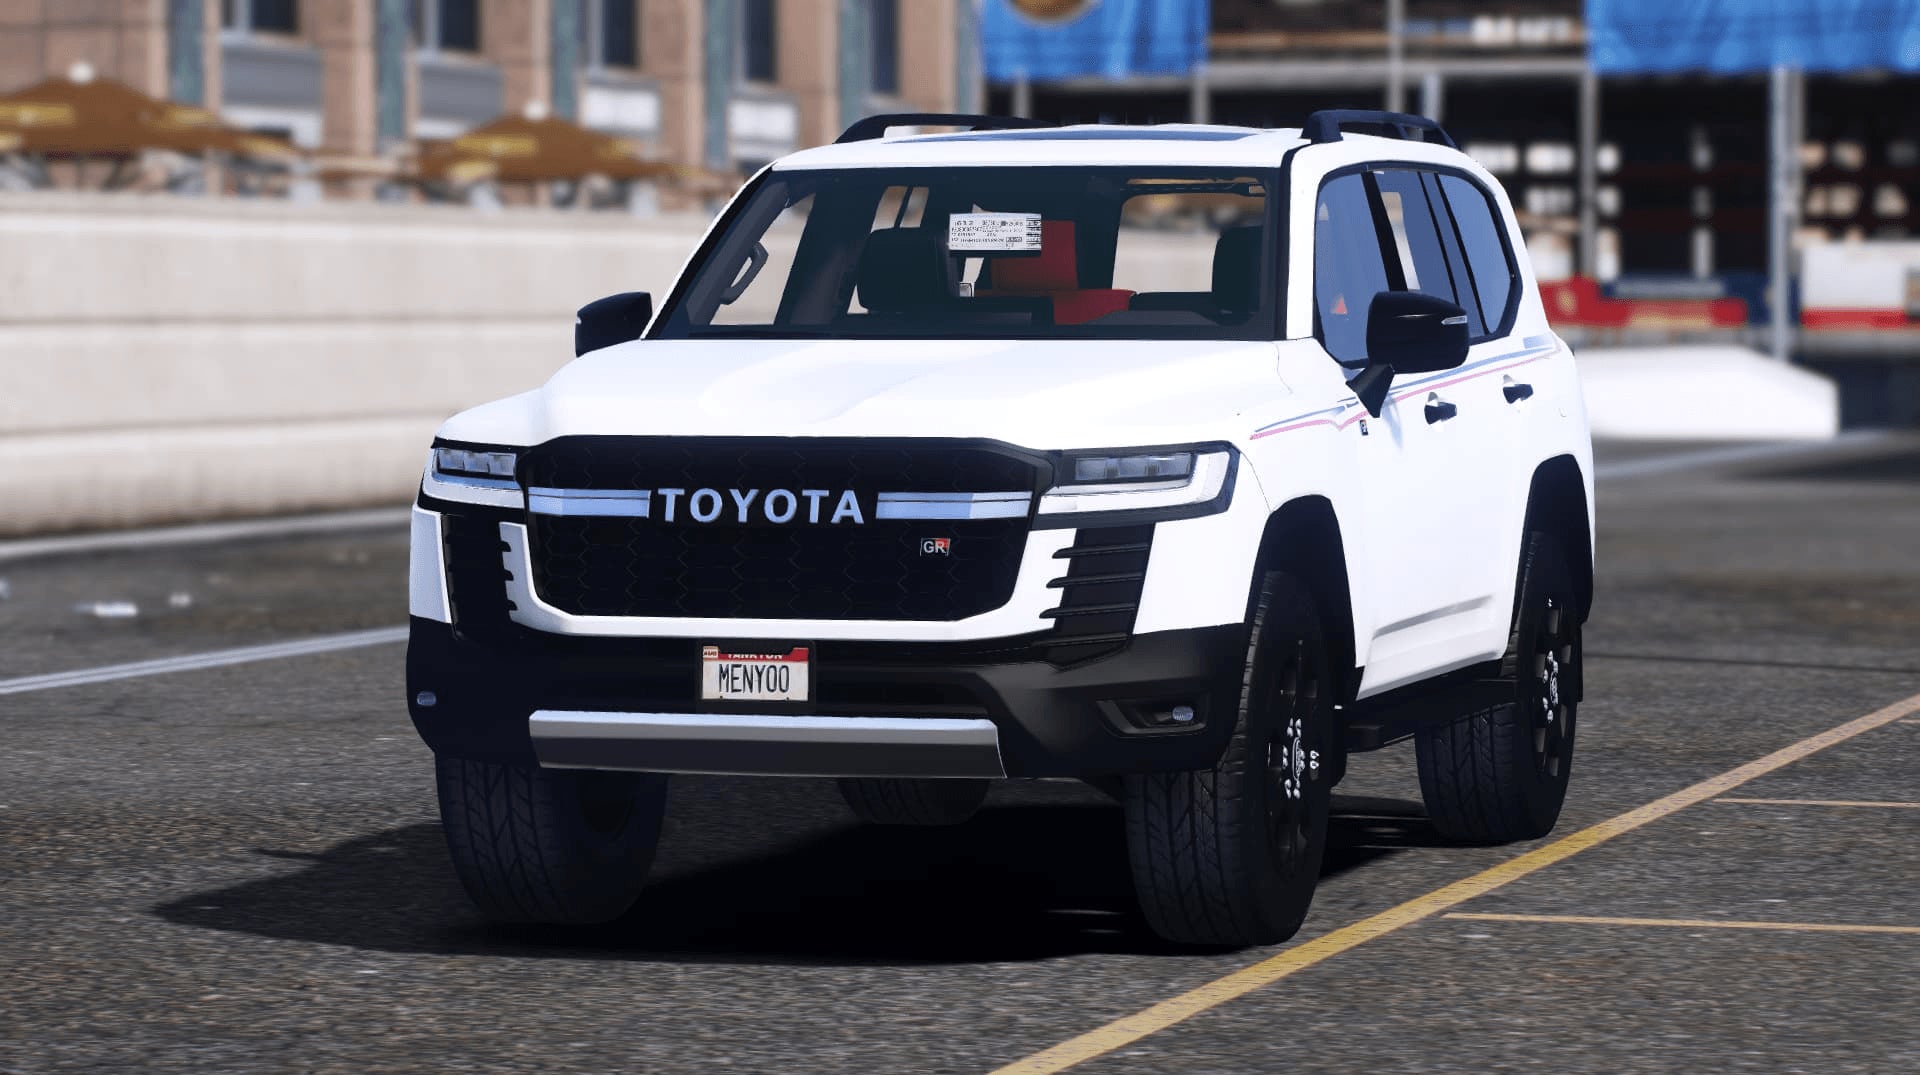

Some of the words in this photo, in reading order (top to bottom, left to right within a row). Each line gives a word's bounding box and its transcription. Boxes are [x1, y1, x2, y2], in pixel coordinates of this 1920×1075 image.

[657, 488, 865, 524] TOYOTA
[922, 540, 947, 554] GR
[718, 663, 790, 694] MENYOO
